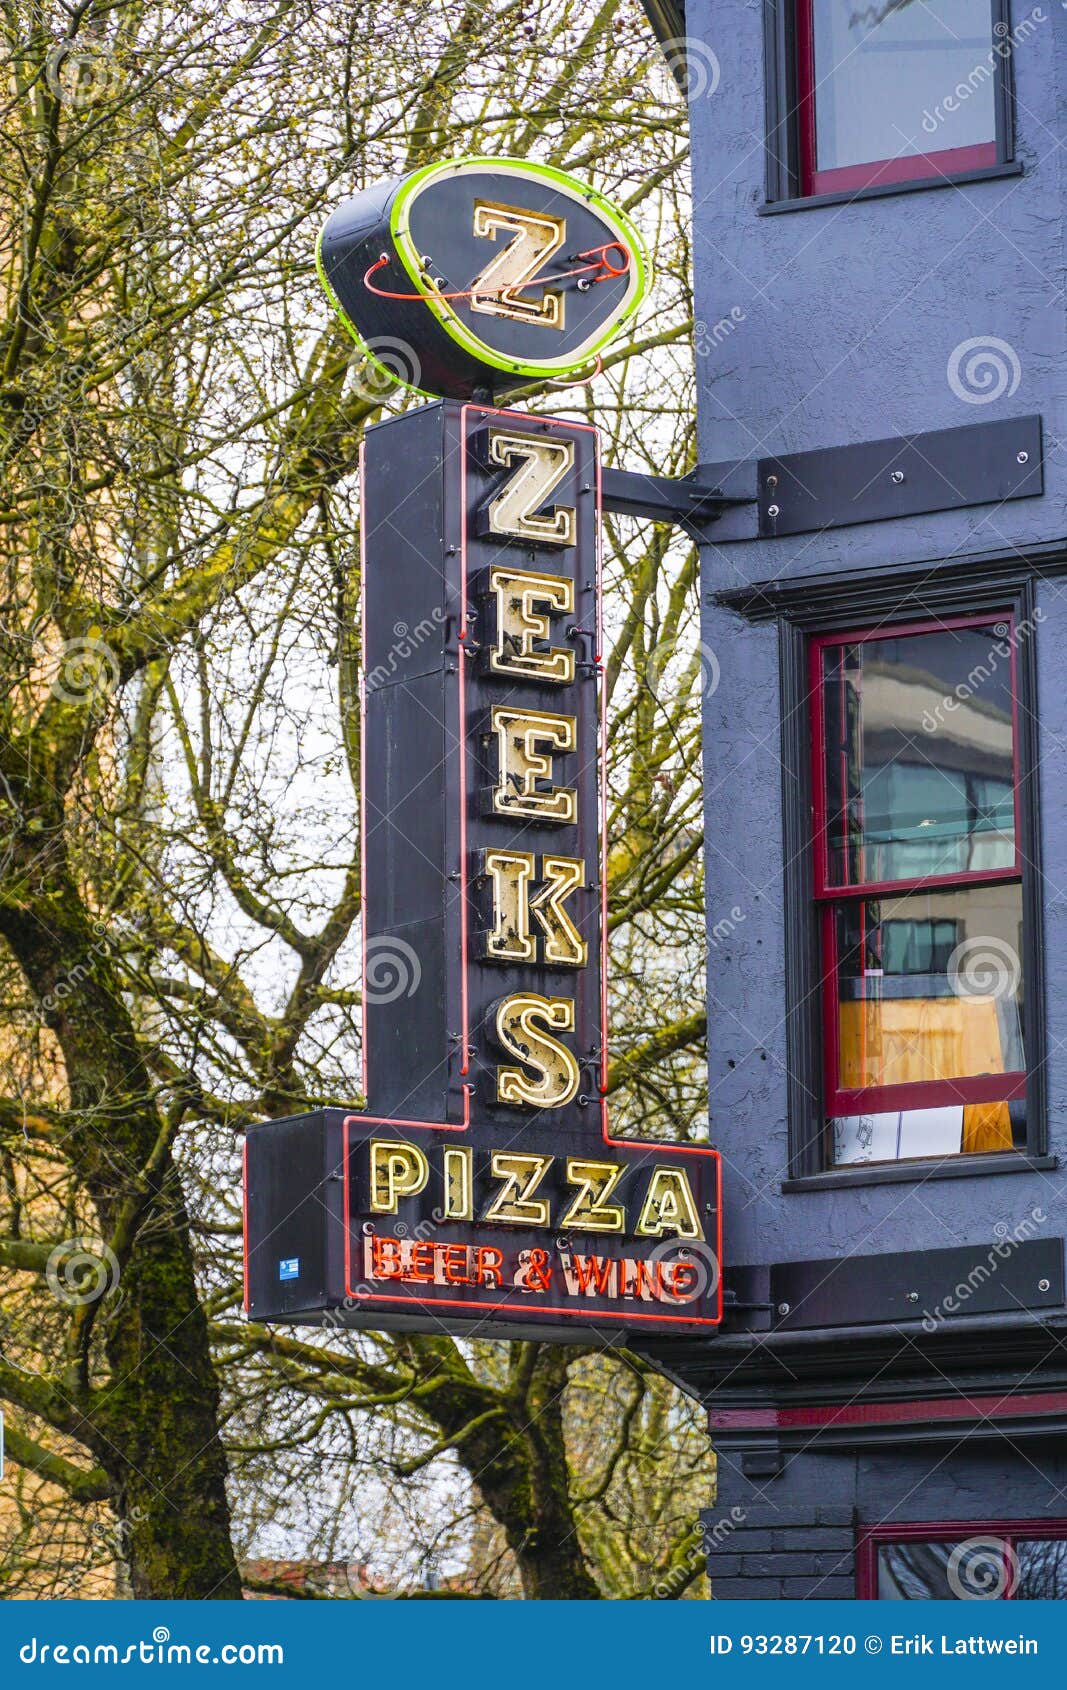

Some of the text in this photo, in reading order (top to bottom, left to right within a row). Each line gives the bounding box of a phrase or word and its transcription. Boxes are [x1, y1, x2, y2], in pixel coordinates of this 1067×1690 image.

[471, 197, 567, 331] Z
[487, 426, 589, 1110] ZEEKS
[369, 1137, 706, 1242] PIZZA
[363, 1234, 695, 1305] BEER & WINE
